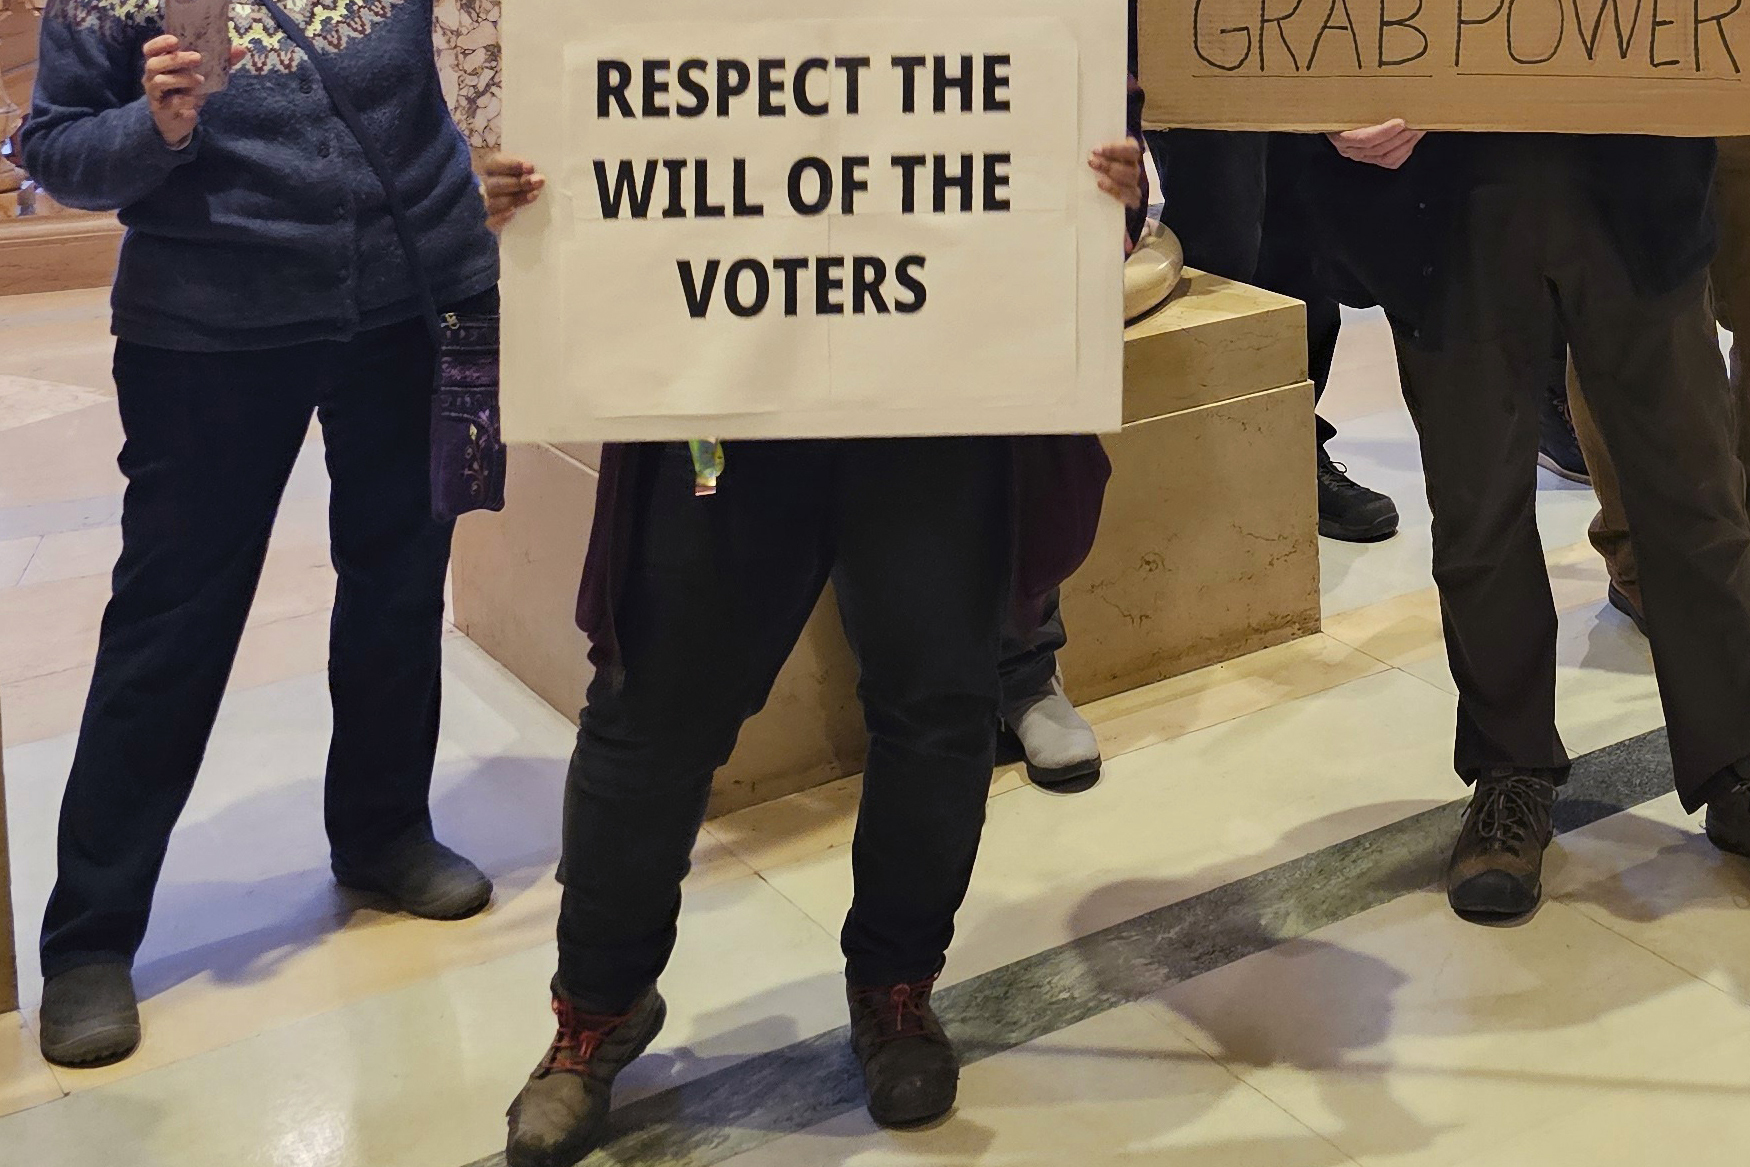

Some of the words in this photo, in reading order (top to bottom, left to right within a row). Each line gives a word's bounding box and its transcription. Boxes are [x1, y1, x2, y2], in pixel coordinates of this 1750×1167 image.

[596, 55, 871, 120] RESPECT
[890, 52, 1012, 115] THE
[592, 157, 765, 220] WILL
[786, 154, 870, 216] OF
[890, 152, 1012, 215] THE
[675, 253, 928, 320] VOTERS
